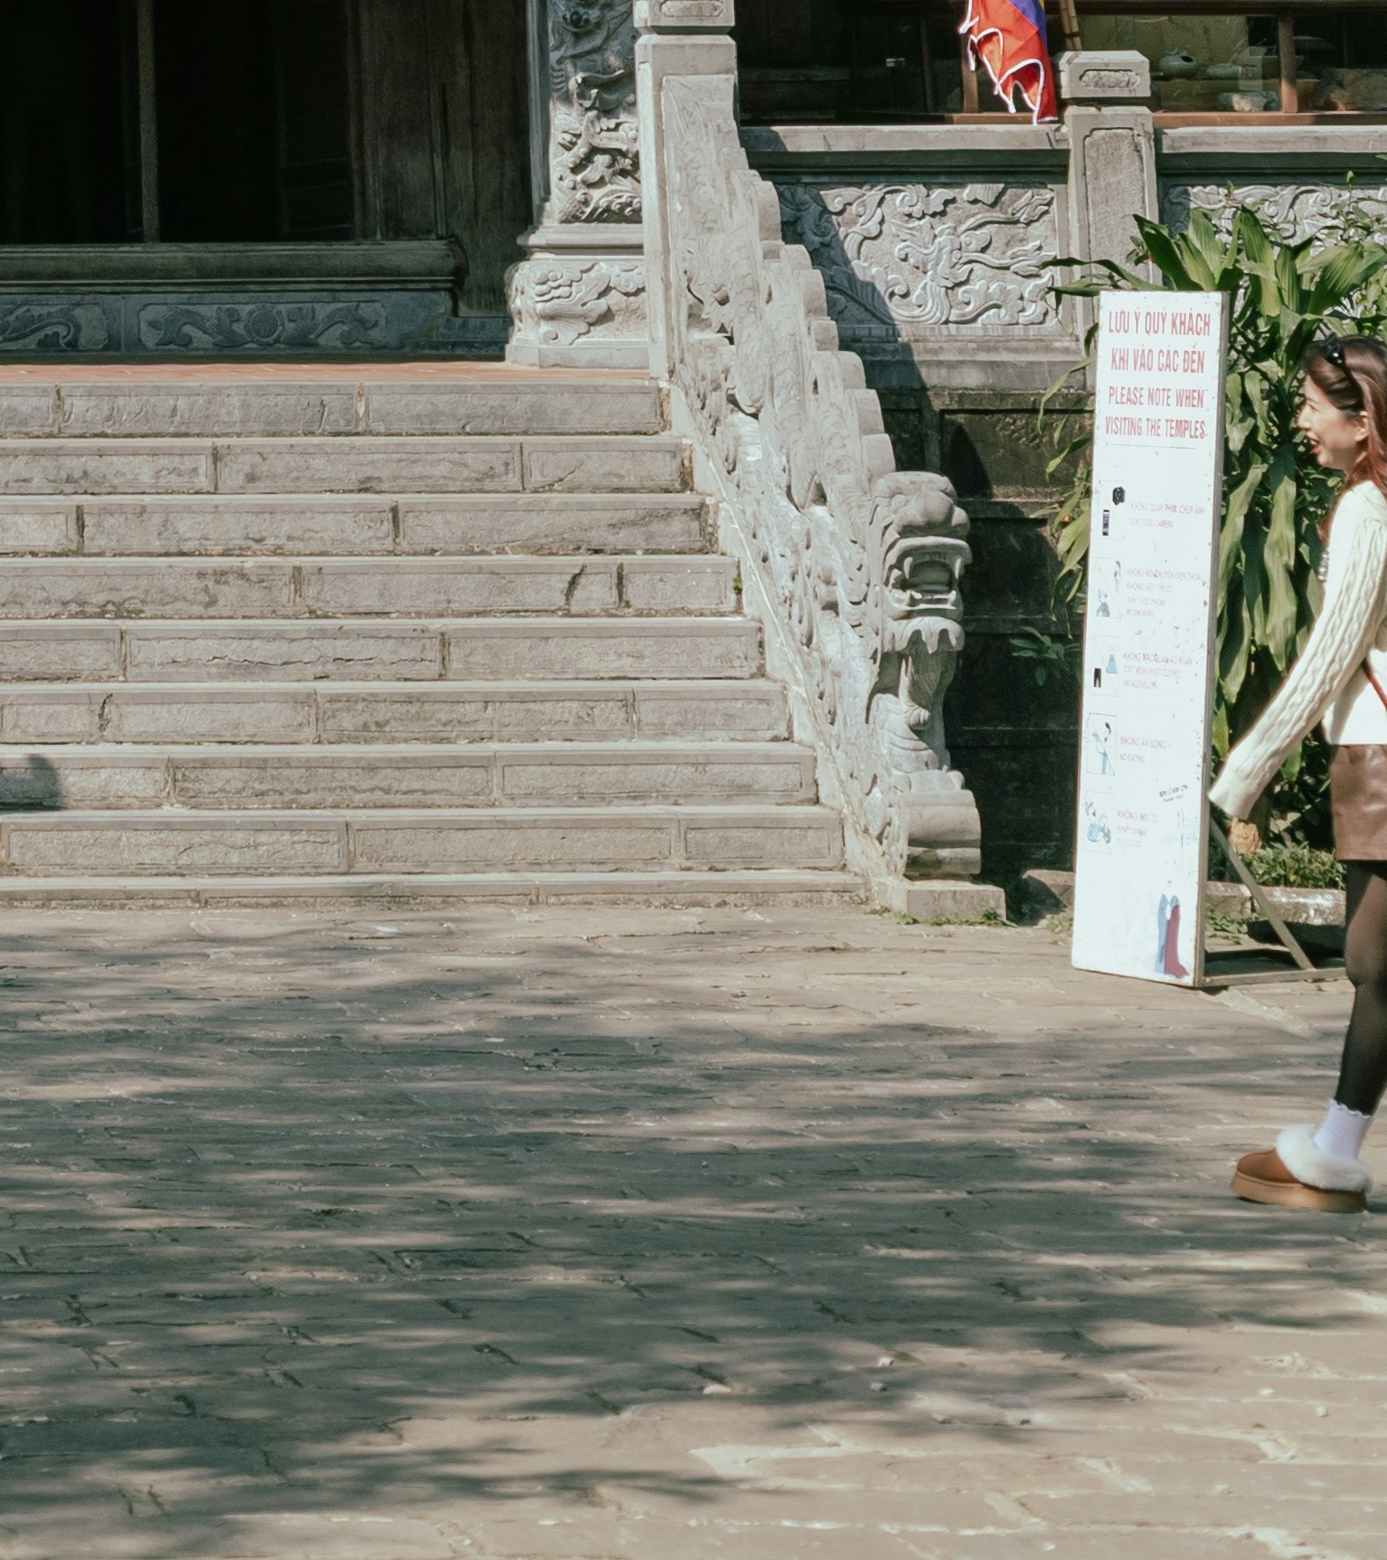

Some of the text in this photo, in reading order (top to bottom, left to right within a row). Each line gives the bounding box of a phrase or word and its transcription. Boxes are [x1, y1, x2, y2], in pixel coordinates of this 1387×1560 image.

[1134, 305, 1141, 335] Ý
[1144, 306, 1167, 337] QUÝ
[1170, 307, 1211, 336] KHÁCH
[1110, 348, 1129, 371] KHI
[1132, 344, 1154, 372] VÀO
[1157, 344, 1179, 373] CÁC
[1108, 385, 1205, 409] PLEASE NOTE WHEN
[1105, 415, 1206, 440] VISITING THE TEMPLES
